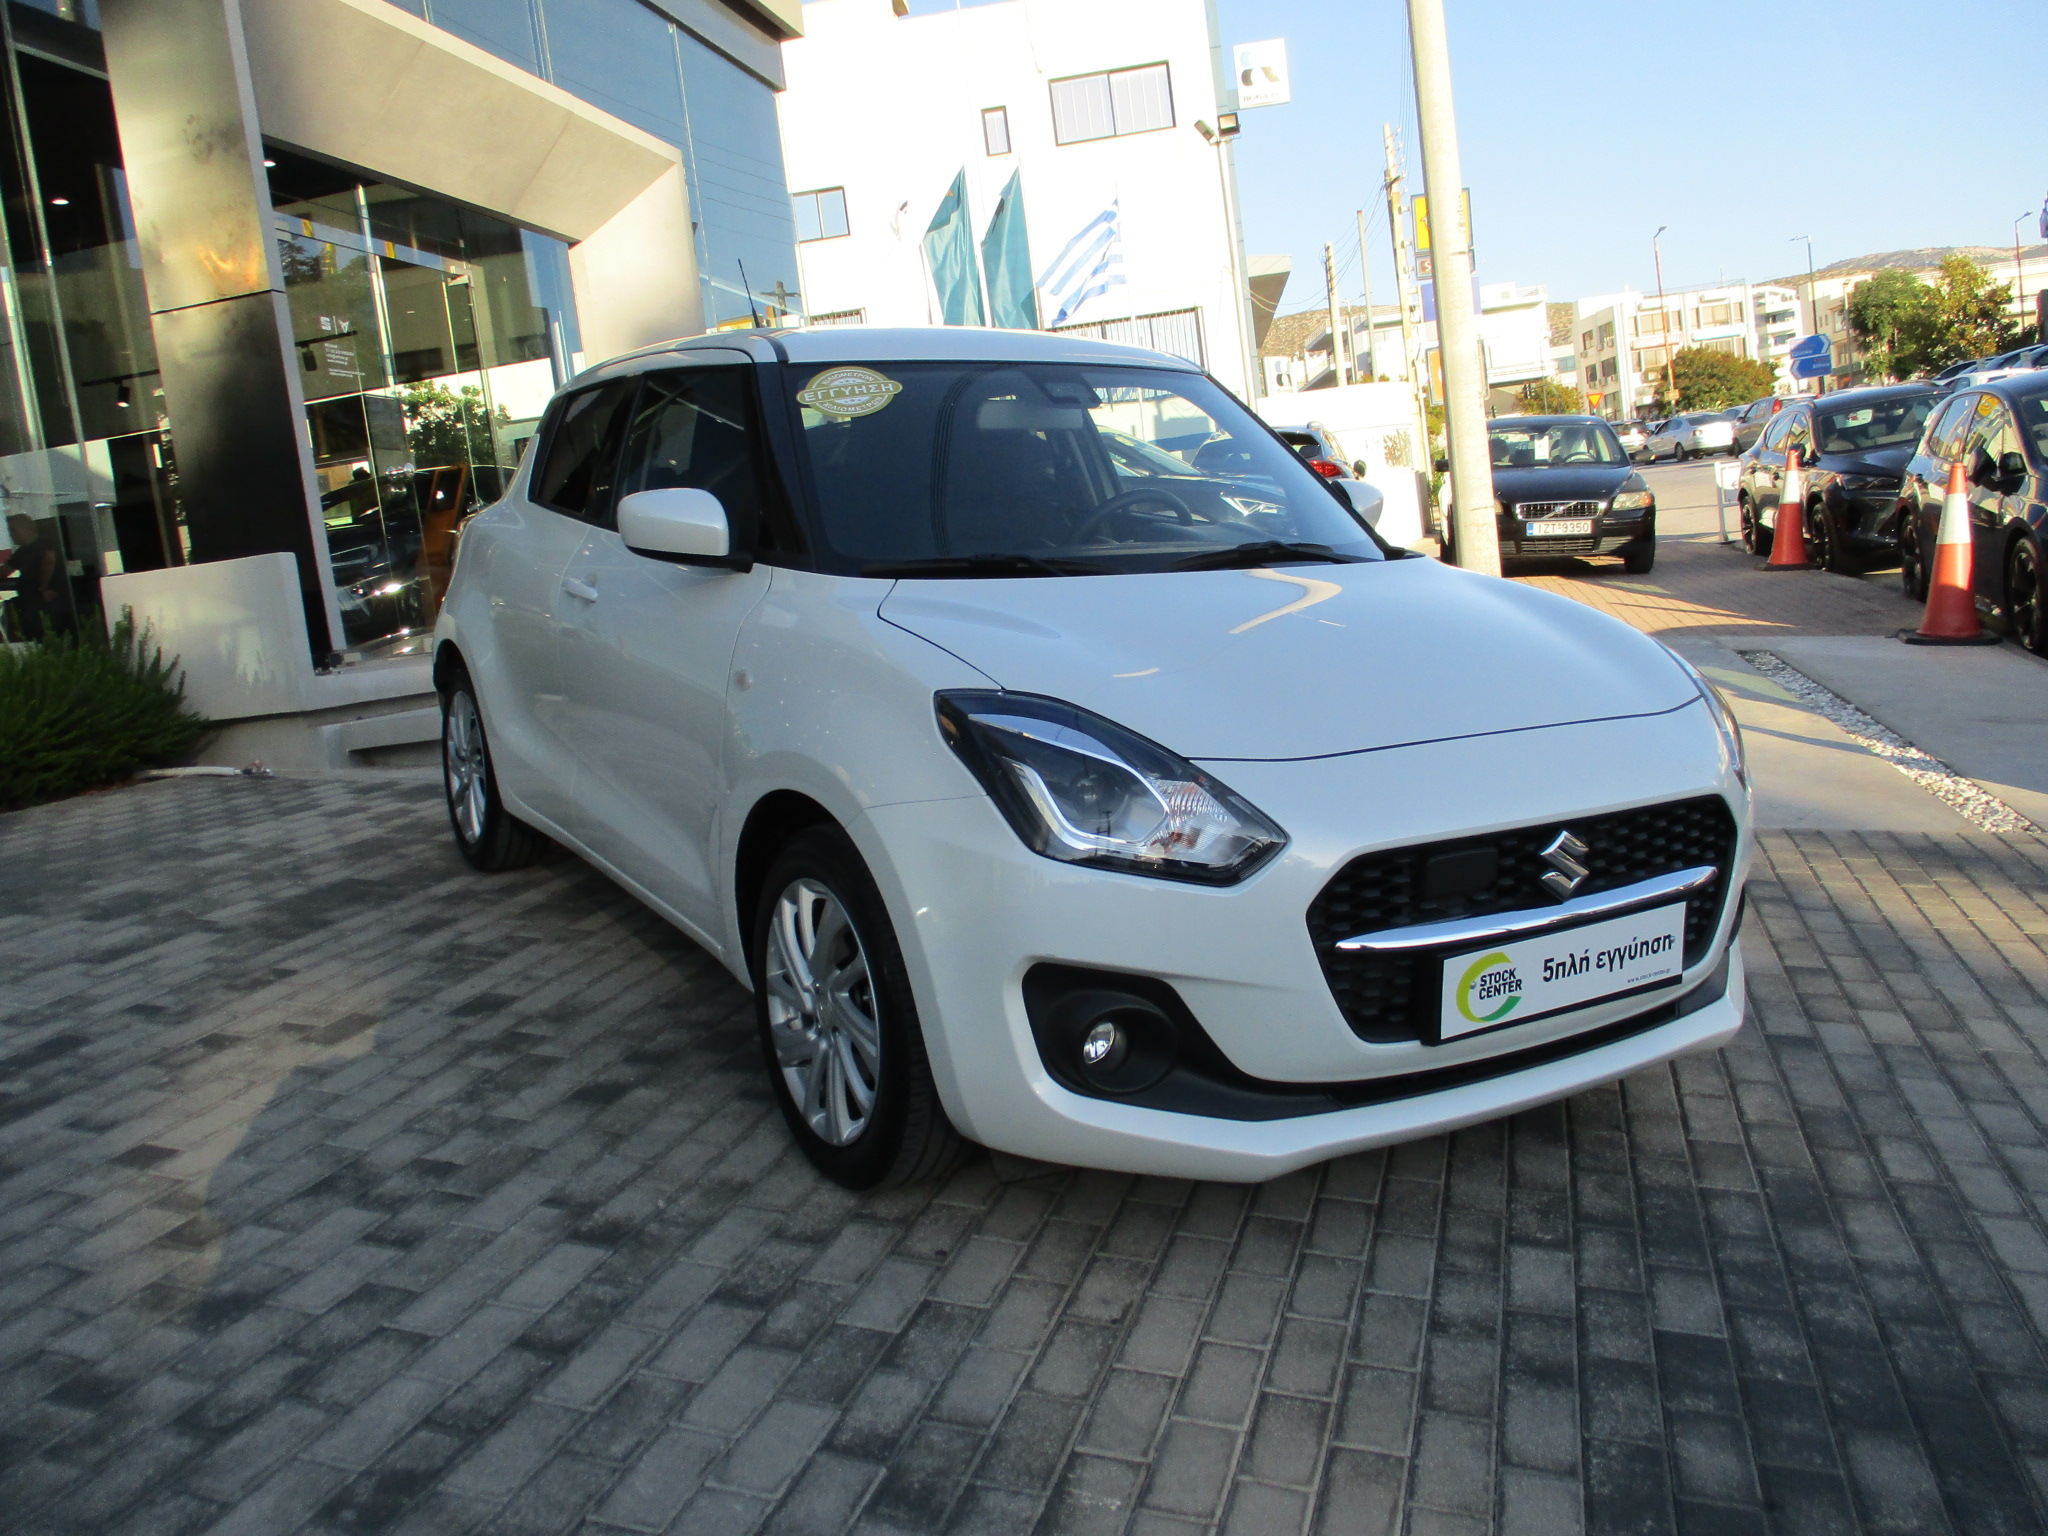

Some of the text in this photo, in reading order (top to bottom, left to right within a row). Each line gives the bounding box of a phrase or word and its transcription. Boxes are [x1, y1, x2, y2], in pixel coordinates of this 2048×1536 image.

[804, 383, 894, 402] ΕΓΓΥΗΣΗ
[1542, 933, 1675, 983] 5πλή εγγύηση
[1479, 967, 1517, 988] STOCK
[1478, 978, 1523, 1000] CENTER
